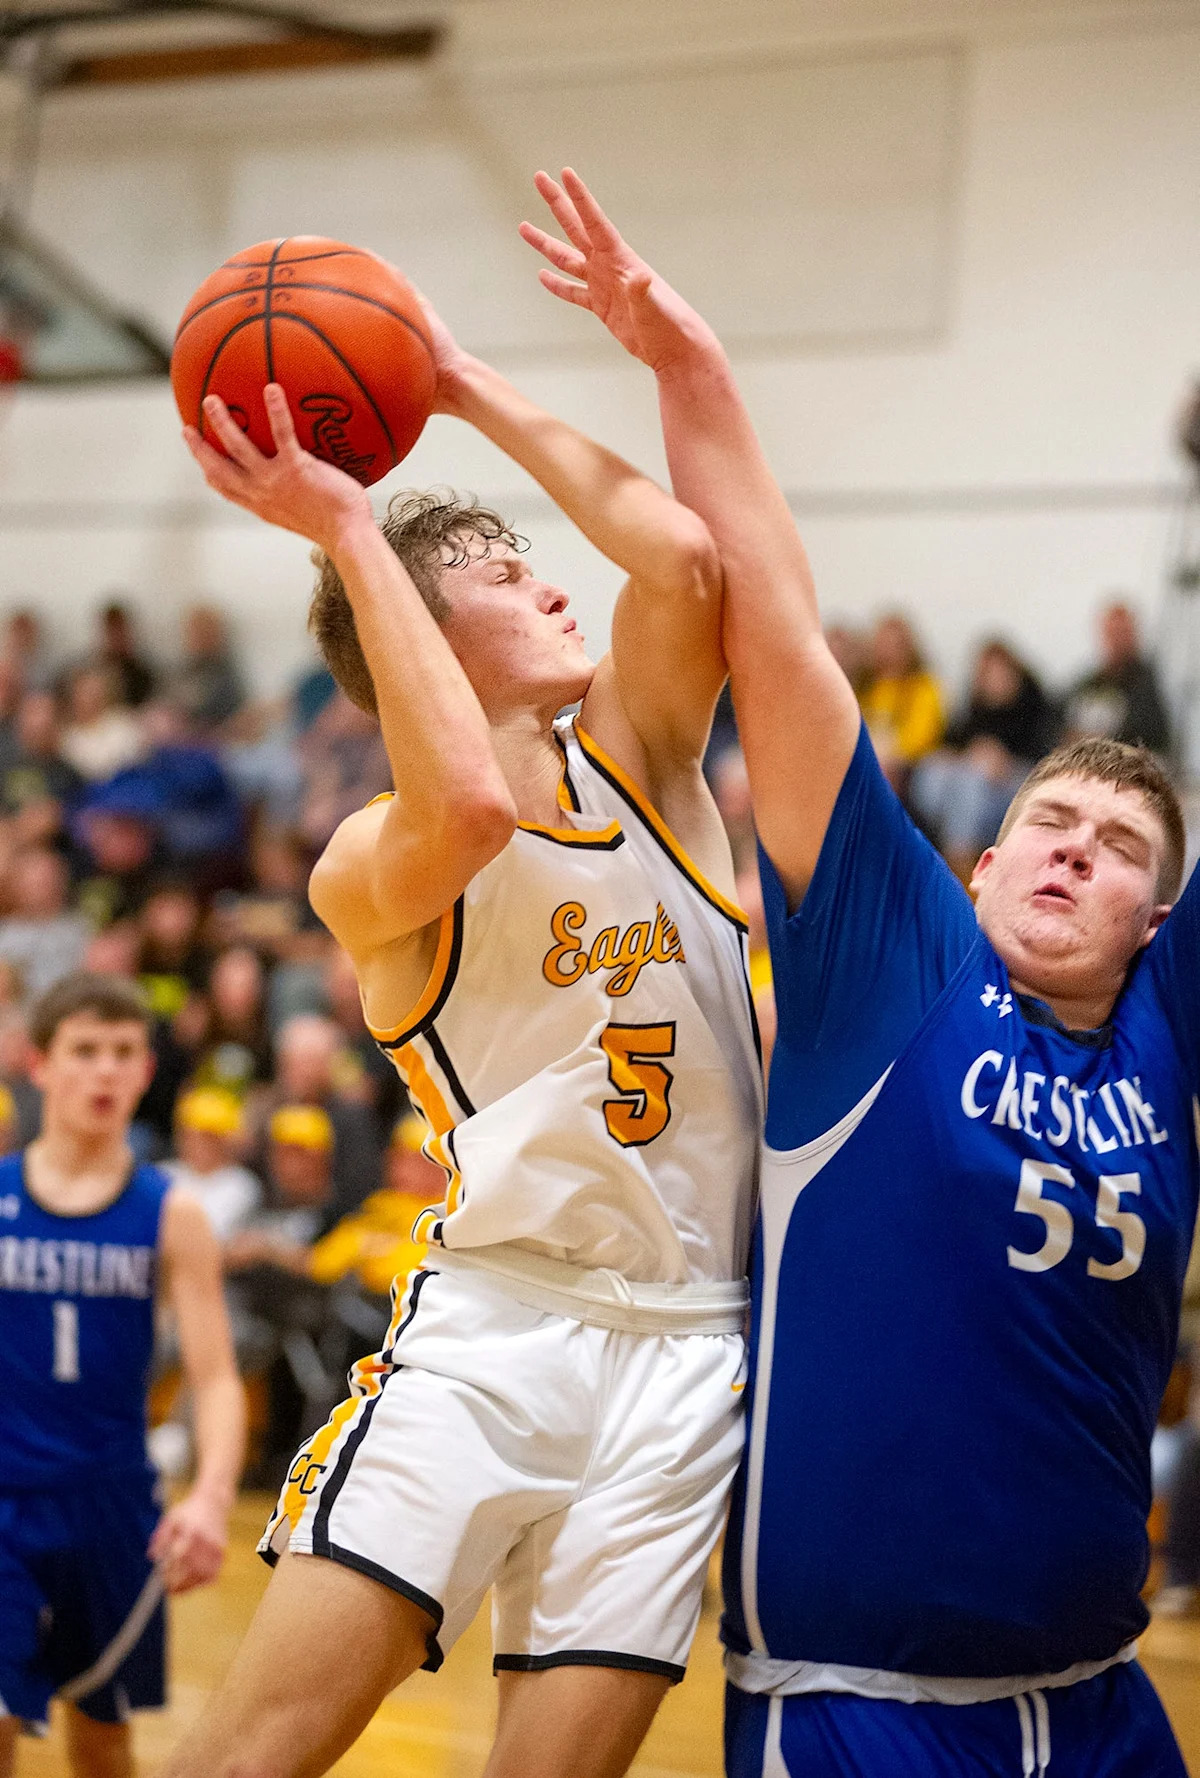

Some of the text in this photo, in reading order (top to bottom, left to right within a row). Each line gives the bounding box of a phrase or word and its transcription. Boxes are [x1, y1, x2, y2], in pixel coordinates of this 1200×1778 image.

[599, 1021, 676, 1148] 5
[1006, 1158, 1146, 1281] 55
[53, 1300, 79, 1382] 1
[288, 1454, 327, 1494] CC
